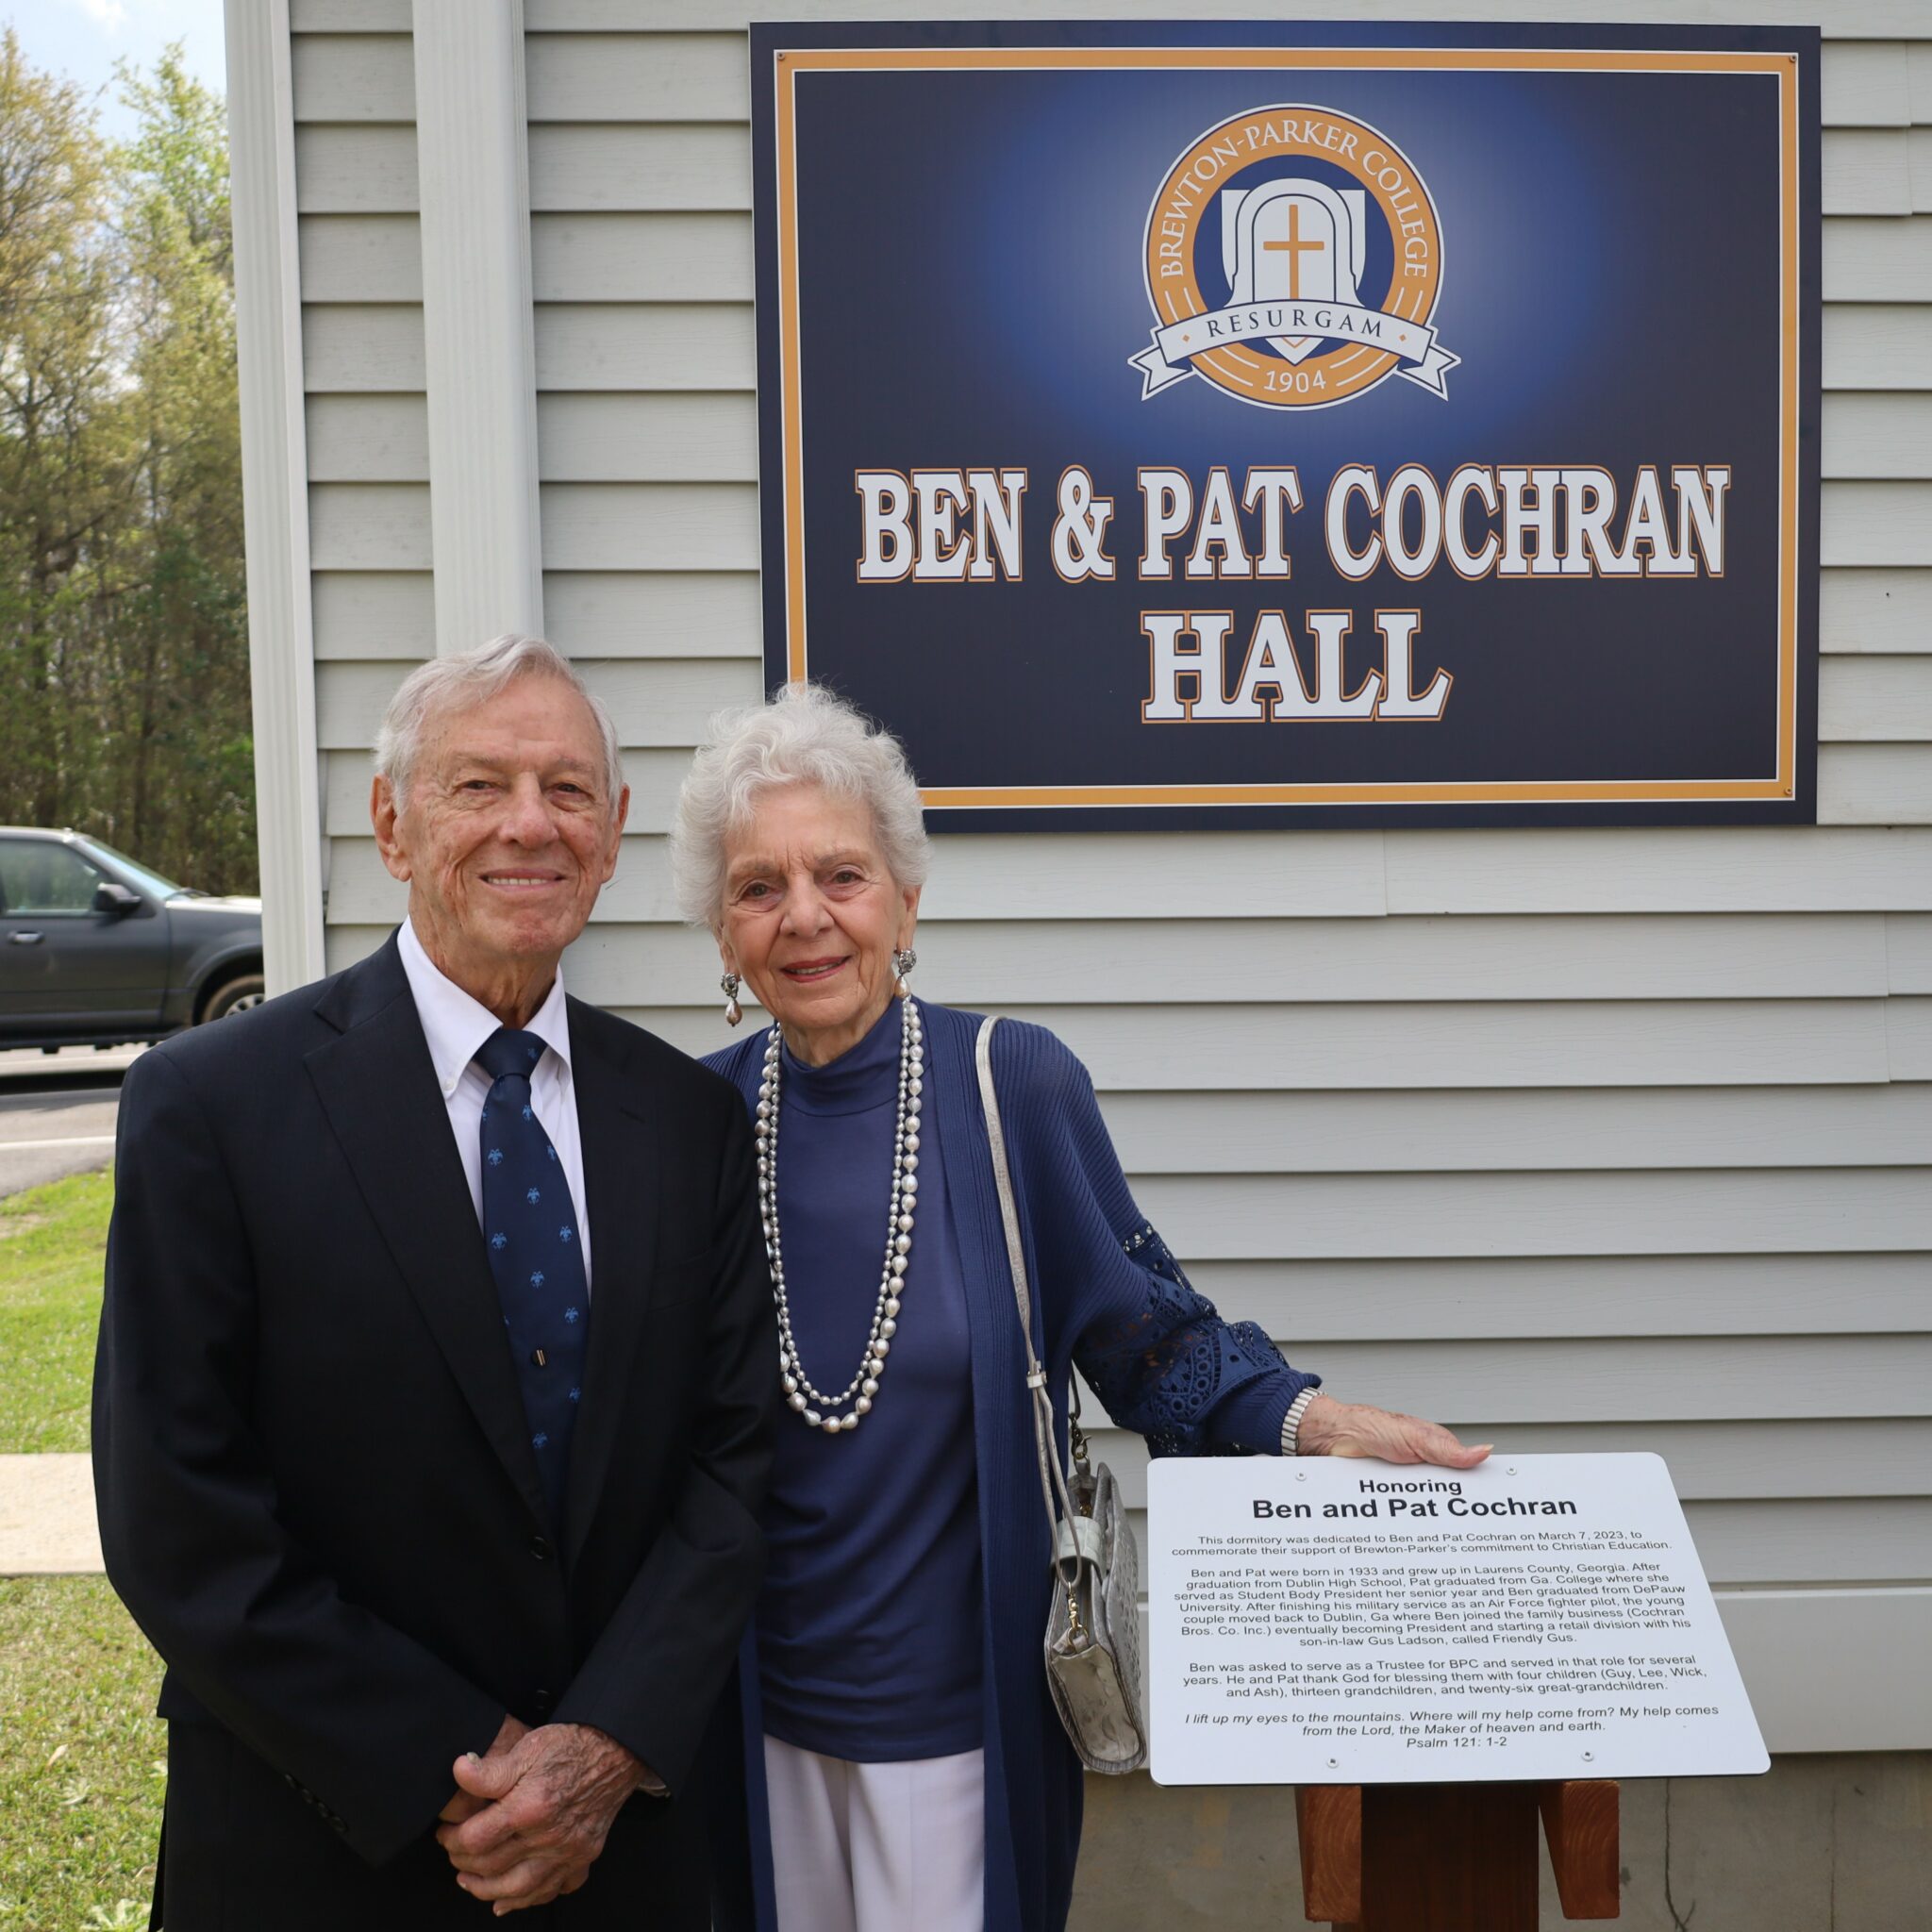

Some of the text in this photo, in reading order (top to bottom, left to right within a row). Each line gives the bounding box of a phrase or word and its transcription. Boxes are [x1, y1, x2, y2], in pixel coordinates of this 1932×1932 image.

[1159, 119, 1429, 279] BREWTON-PARKER COLLEGE
[1207, 308, 1383, 339] RESURGAM
[1264, 369, 1327, 393] 1904
[856, 462, 1731, 583] BEN & PAT COCHRAN
[1141, 608, 1454, 724] HALL
[1358, 1478, 1462, 1496] Honoring
[1253, 1496, 1577, 1519] Ben and Pat Cochran
[1197, 1536, 1224, 1545] This
[1226, 1535, 1283, 1545] dormitory
[1312, 1534, 1372, 1544] dedicated
[1374, 1534, 1387, 1543] to
[1389, 1534, 1413, 1543] Ben
[1416, 1533, 1440, 1542] and
[1441, 1533, 1463, 1542] Pat
[1466, 1532, 1517, 1542] Cochran
[1520, 1533, 1536, 1541] on
[1538, 1531, 1576, 1541] March
[1630, 1531, 1642, 1540] to
[1171, 1546, 1257, 1557] commemorate
[1260, 1545, 1288, 1556] their
[1291, 1545, 1337, 1557] support
[1339, 1545, 1351, 1555] of
[1460, 1543, 1535, 1553] commitment
[1536, 1542, 1549, 1552] to
[1552, 1541, 1606, 1551] Christian
[1191, 1569, 1216, 1578] Ben
[1219, 1568, 1241, 1578] and
[1245, 1568, 1267, 1577] Pat
[1269, 1569, 1299, 1577] were
[1302, 1567, 1330, 1576] born
[1333, 1567, 1344, 1576] in
[1348, 1566, 1378, 1576] 1933
[1381, 1566, 1405, 1576] and
[1407, 1567, 1439, 1577] grew
[1441, 1567, 1457, 1576] up
[1459, 1565, 1472, 1574] in
[1474, 1565, 1524, 1574] Laurens
[1631, 1561, 1660, 1572] After
[1186, 1579, 1252, 1591] graduation
[1254, 1579, 1283, 1589] from
[1286, 1578, 1325, 1589] Dublin
[1328, 1577, 1357, 1590] High
[1409, 1577, 1431, 1587] Pat
[1433, 1575, 1496, 1589] graduated
[1498, 1575, 1527, 1586] from
[1556, 1574, 1603, 1586] College
[1605, 1574, 1644, 1583] where
[1646, 1573, 1670, 1583] she
[1245, 1602, 1276, 1612] After
[1278, 1601, 1331, 1613] finishing
[1333, 1601, 1353, 1610] his
[1356, 1600, 1400, 1612] military
[1403, 1599, 1448, 1610] service
[1451, 1601, 1466, 1609] as
[1488, 1598, 1506, 1608] Air
[1507, 1598, 1544, 1608] Force
[1547, 1597, 1587, 1609] fighter
[1622, 1596, 1643, 1606] the
[1645, 1596, 1685, 1607] young
[1274, 1624, 1339, 1637] eventually
[1341, 1624, 1404, 1636] becoming
[1407, 1623, 1467, 1633] President
[1470, 1622, 1494, 1632] and
[1496, 1621, 1544, 1634] starting
[1547, 1623, 1556, 1631] a
[1558, 1620, 1590, 1631] retail
[1592, 1620, 1641, 1630] division
[1642, 1619, 1670, 1629] with
[1672, 1618, 1691, 1628] his
[1368, 1636, 1394, 1646] Gus
[1452, 1634, 1490, 1644] called
[1492, 1633, 1543, 1645] Friendly
[1190, 1655, 1696, 1673] Ben was asked to serve as a Trustee for BPC and served in that role for several
[1226, 1687, 1251, 1698] and
[1291, 1686, 1341, 1697] thirteen
[1441, 1684, 1465, 1695] and
[1185, 1714, 1190, 1724] I
[1192, 1713, 1208, 1724] lift
[1212, 1715, 1229, 1725] up
[1232, 1715, 1254, 1726] my
[1256, 1714, 1289, 1725] eyes
[1291, 1713, 1305, 1724] to
[1308, 1712, 1329, 1723] the
[1409, 1710, 1454, 1722] Where
[1457, 1709, 1478, 1721] will
[1481, 1711, 1502, 1723] my
[1505, 1708, 1534, 1722] help
[1537, 1709, 1574, 1719] come
[1620, 1706, 1640, 1719] My
[1643, 1706, 1672, 1719] help
[1674, 1707, 1719, 1716] comes
[1303, 1725, 1333, 1737] from
[1336, 1725, 1357, 1736] the
[1399, 1724, 1421, 1735] the
[1424, 1724, 1467, 1735] Maker
[1469, 1723, 1484, 1734] of
[1486, 1723, 1535, 1734] heaven
[1539, 1721, 1564, 1732] and
[1407, 1736, 1507, 1749] Psalm 121: 1-2
